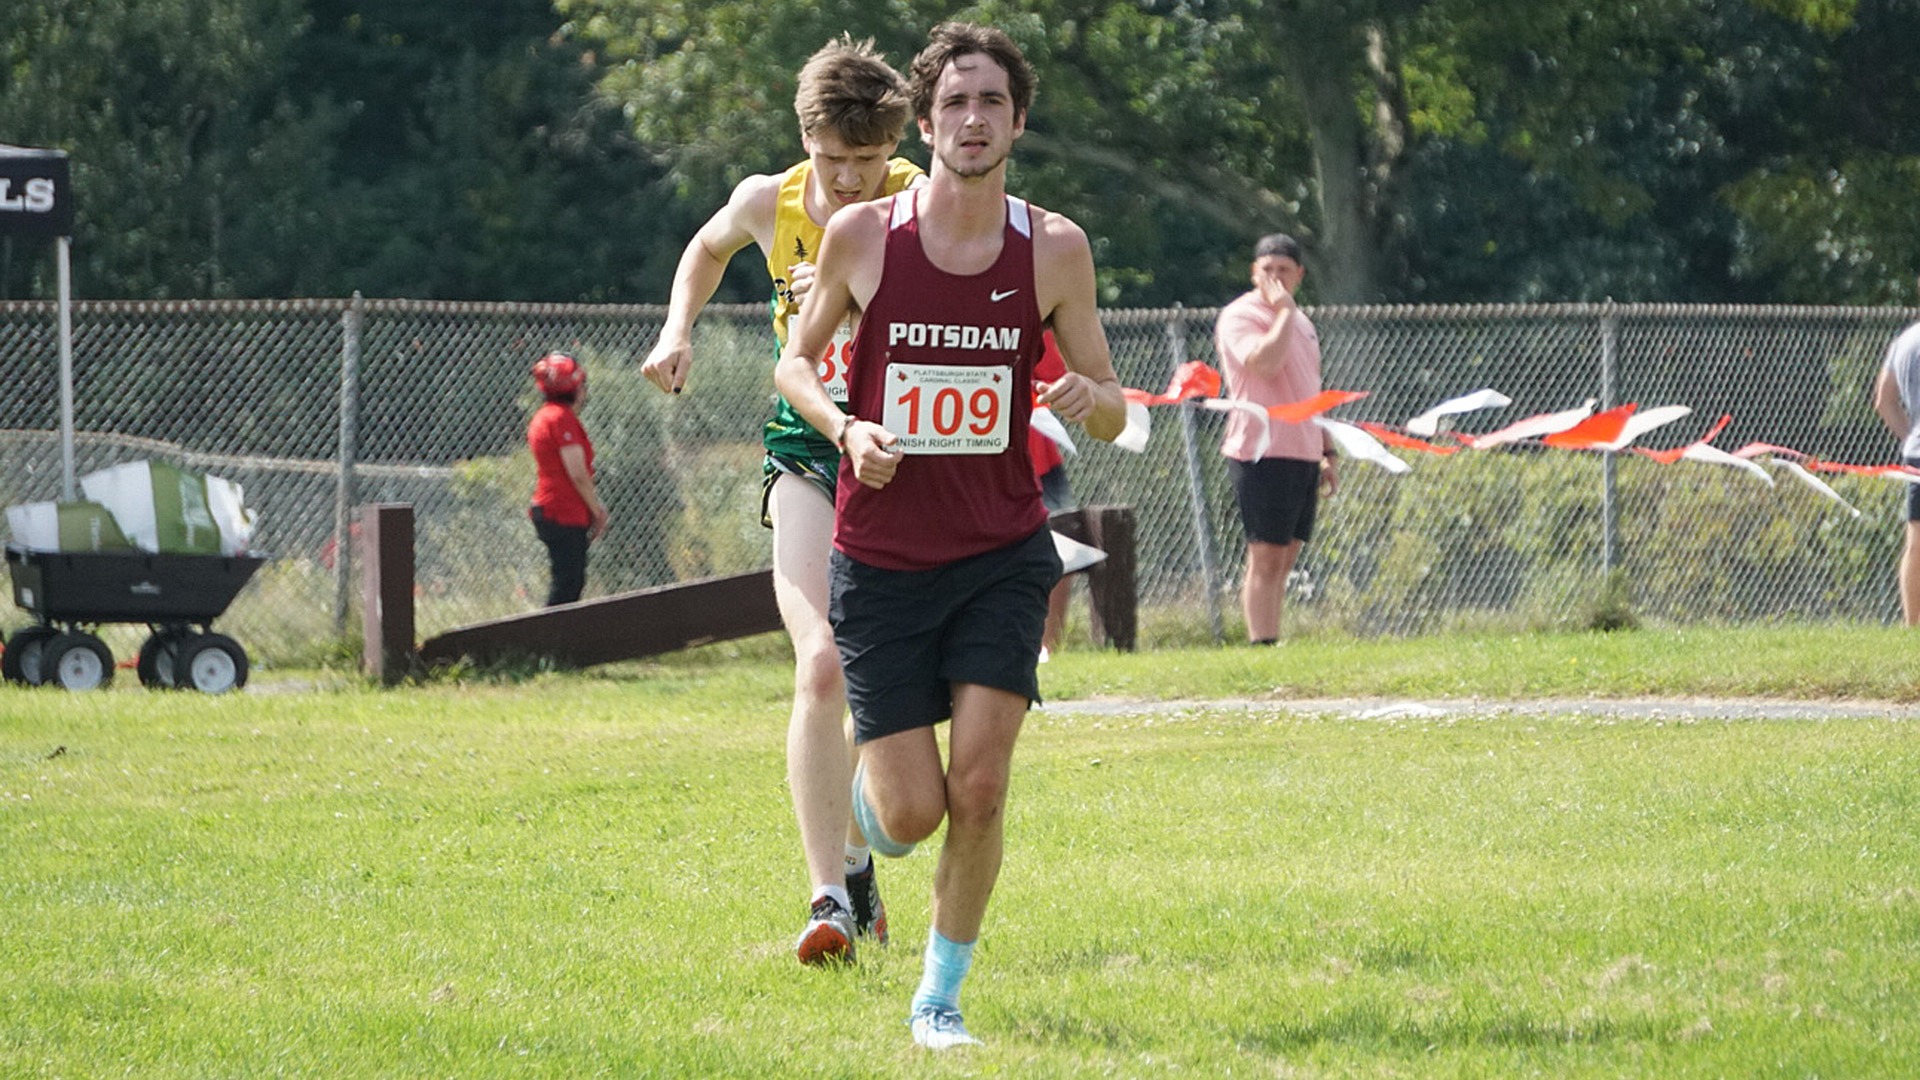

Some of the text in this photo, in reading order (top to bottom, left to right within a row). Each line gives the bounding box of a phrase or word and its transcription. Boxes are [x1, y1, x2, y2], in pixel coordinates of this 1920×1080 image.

[889, 322, 1021, 350] POTSDAM
[898, 386, 999, 435] 109
[896, 437, 1002, 448] NISH RIGHT TIMING
